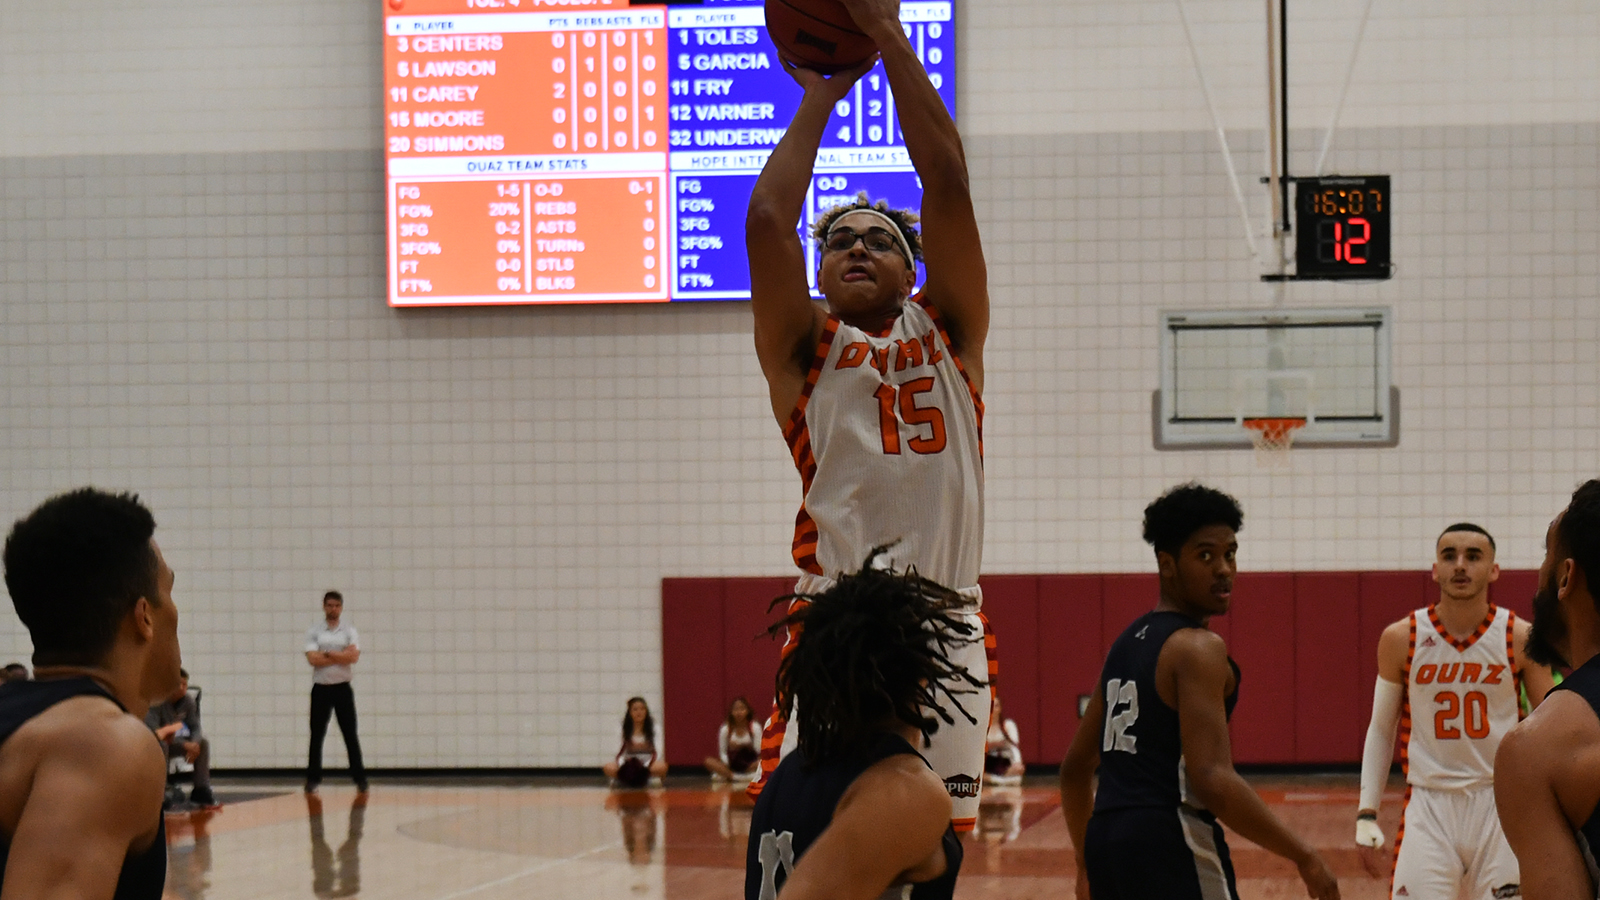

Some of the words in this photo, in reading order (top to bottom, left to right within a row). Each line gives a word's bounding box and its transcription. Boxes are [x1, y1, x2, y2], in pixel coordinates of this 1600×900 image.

[696, 14, 736, 22] PLAYER
[927, 8, 945, 17] FLS
[414, 21, 454, 31] PLAYER
[549, 18, 569, 27] PTS
[576, 18, 602, 26] REBS
[606, 17, 633, 26] ASTS
[641, 16, 660, 25] FLS
[412, 35, 503, 52] CENTERS
[551, 33, 565, 48] 0
[582, 31, 596, 47] 0
[612, 31, 626, 47] 0
[644, 30, 653, 46] 1
[679, 29, 688, 45] 1
[695, 28, 758, 45] TOLES
[928, 23, 942, 39] 0
[412, 60, 496, 77] LAWSON
[551, 57, 565, 73] 0
[585, 56, 594, 72] 1
[613, 56, 627, 72] 0
[642, 55, 656, 71] 0
[678, 54, 690, 70] 5
[694, 52, 770, 71] GARCIA
[928, 47, 942, 64] 0
[390, 87, 408, 102] 11
[412, 85, 479, 102] CAREY
[553, 82, 565, 98] 2
[583, 82, 597, 98] 0
[613, 81, 627, 97] 0
[642, 80, 656, 96] 0
[671, 79, 689, 95] 11
[694, 79, 733, 96] FRY
[869, 75, 880, 91] 1
[389, 112, 410, 127] 15
[413, 110, 484, 127] MOORE
[552, 107, 566, 124] 0
[583, 107, 597, 123] 0
[613, 106, 627, 122] 0
[645, 105, 654, 121] 1
[671, 105, 691, 120] 12
[694, 103, 774, 120] VARNER
[836, 100, 850, 117] 0
[868, 99, 882, 116] 2
[388, 137, 410, 152] 20
[413, 135, 504, 152] SIMMONS
[552, 133, 566, 149] 0
[584, 132, 598, 148] 0
[614, 131, 628, 147] 0
[643, 131, 657, 146] 0
[670, 130, 691, 146] 32
[836, 125, 850, 142] 4
[868, 125, 882, 142] 0
[467, 161, 503, 172] OUAZ
[507, 161, 544, 171] TEAM
[548, 159, 588, 170] STATS
[691, 157, 727, 168] HOPE
[734, 156, 770, 166] INTE
[849, 153, 885, 164] TEAM
[399, 186, 420, 199] FG
[497, 183, 519, 197] 1-5
[534, 182, 563, 196] O-D
[628, 180, 653, 194] 0-1
[680, 181, 701, 194] FG
[817, 176, 847, 191] O-D
[399, 205, 433, 218] FG%
[489, 203, 520, 217] 20%
[535, 202, 577, 215] REBS
[680, 199, 714, 212] FG%
[1314, 190, 1382, 215] 16:07
[400, 223, 429, 237] 3FG
[495, 221, 520, 235] 0-2
[536, 220, 576, 234] ASTS
[643, 218, 654, 232] 0
[680, 218, 710, 231] 3FG
[400, 242, 442, 255] 3FG%
[497, 240, 521, 254] 0%
[536, 239, 585, 252] TURNs
[643, 237, 654, 251] 0
[680, 237, 723, 250] 3FG%
[1334, 217, 1371, 264] 12
[400, 261, 419, 274] FT
[496, 258, 521, 272] 0-0
[536, 258, 574, 271] STLS
[643, 256, 654, 270] 0
[681, 255, 699, 268] FT
[400, 279, 433, 293] FT%
[497, 277, 521, 291] 0%
[536, 277, 575, 290] BLKS
[644, 274, 655, 288] 0
[681, 274, 713, 288] FT%
[873, 376, 947, 455] 15
[1415, 662, 1506, 685] OUAZ
[1103, 678, 1139, 755] 12
[1433, 691, 1490, 740] 20
